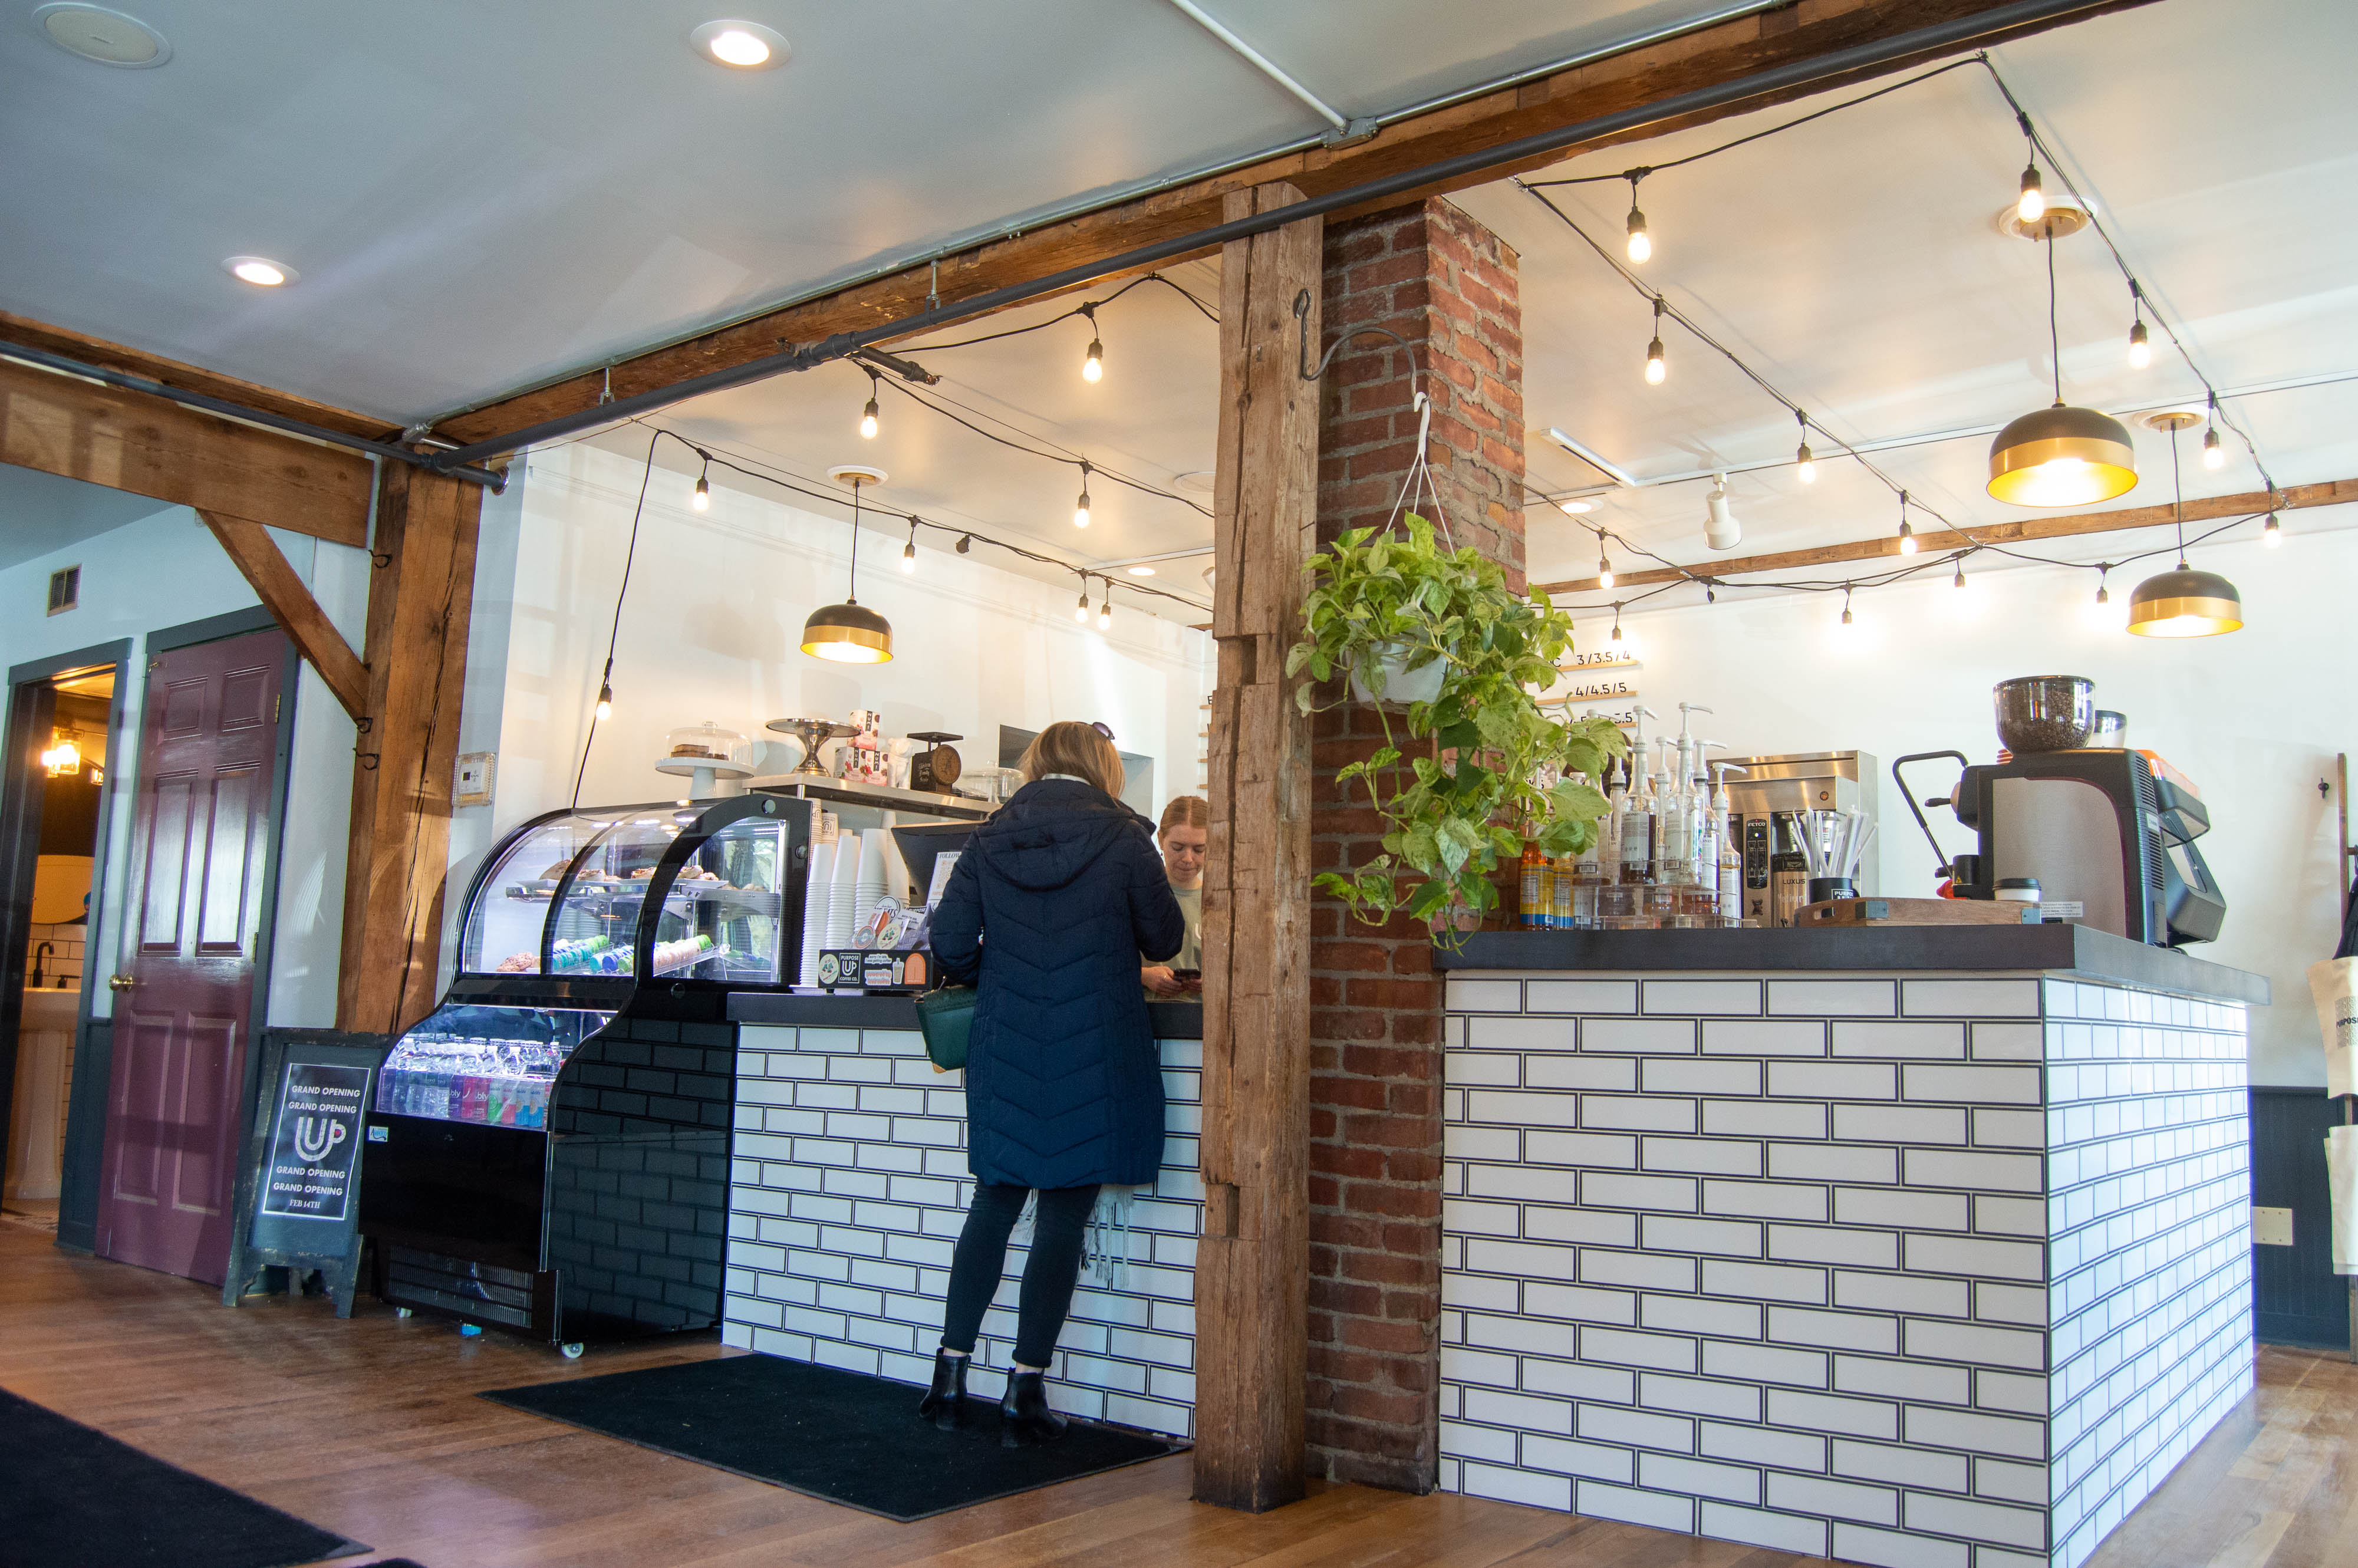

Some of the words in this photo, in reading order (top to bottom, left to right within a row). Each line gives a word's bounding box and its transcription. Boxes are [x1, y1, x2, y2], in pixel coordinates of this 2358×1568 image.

[842, 961, 857, 976] UP
[2336, 1017, 2358, 1028] PURPOS
[292, 1085, 320, 1094] GRAND
[322, 1087, 361, 1098] OPENING
[476, 1091, 489, 1101] bly
[289, 1101, 317, 1111] GRAND
[320, 1103, 357, 1114] OPENING
[295, 1116, 347, 1162] UP
[276, 1165, 305, 1175] GRAND
[308, 1168, 345, 1179] OPENING
[273, 1182, 302, 1192] GRAND
[305, 1185, 343, 1196] OPENING
[289, 1199, 302, 1207] FEB
[304, 1200, 321, 1208] 14TH
